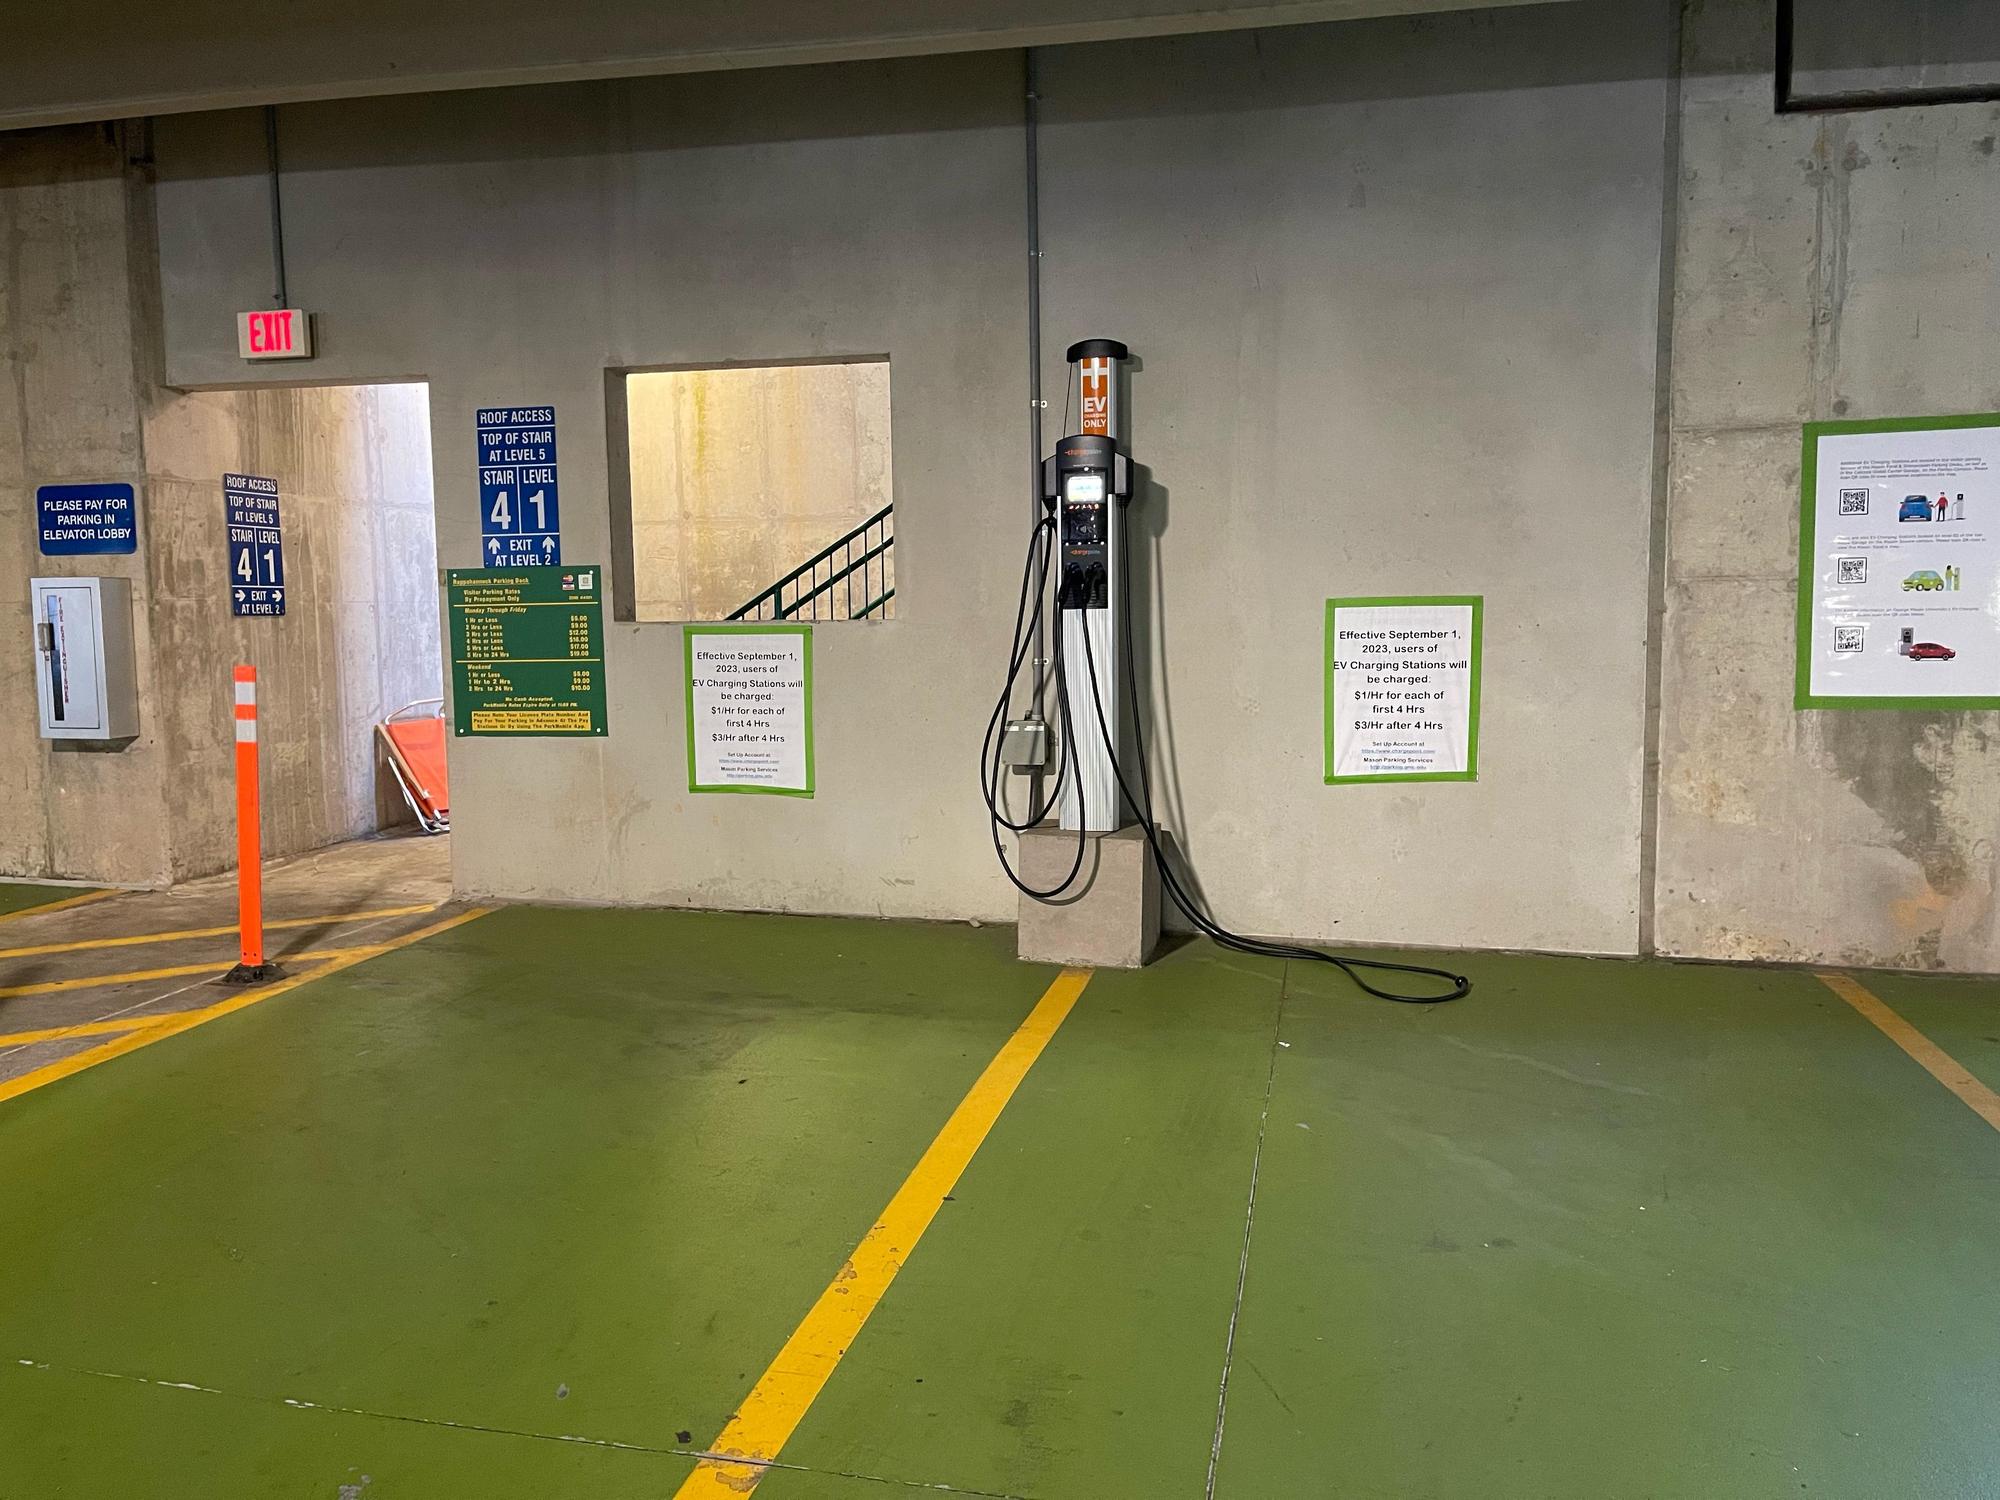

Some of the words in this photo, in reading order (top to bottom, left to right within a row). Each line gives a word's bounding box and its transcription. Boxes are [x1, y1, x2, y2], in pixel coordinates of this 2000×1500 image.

[249, 312, 292, 352] EXIT
[1084, 397, 1106, 412] EV
[480, 411, 508, 424] ROOF
[511, 409, 551, 422] ACCESS
[1084, 420, 1106, 428] ONLY
[482, 433, 501, 445] TOP
[506, 433, 518, 444] OF
[522, 431, 551, 443] STAIR
[490, 450, 501, 461] AT
[505, 449, 536, 461] LEVEL
[540, 449, 545, 460] 5
[484, 470, 514, 485] STAIR
[523, 469, 554, 483] LEVEL
[227, 476, 246, 488] ROOF
[249, 479, 276, 492] ACCESS
[44, 501, 82, 511] PLEASE
[85, 500, 103, 510] PAY
[106, 499, 127, 509] FOR
[229, 496, 243, 507] TOP
[246, 497, 254, 508] OF
[257, 499, 277, 510] STAIR
[529, 490, 545, 528] 1
[491, 492, 511, 530] 4
[57, 514, 101, 525] PARKING
[105, 514, 114, 524] IN
[235, 511, 243, 522] AT
[246, 512, 267, 523] LEVEL
[269, 514, 273, 524] 5
[44, 529, 95, 540] ELEVATOR
[98, 528, 131, 538] LOBBY
[232, 529, 253, 542] STAIR
[259, 531, 280, 544] LEVEL
[510, 539, 532, 551] EXIT
[237, 548, 252, 582] 4
[264, 549, 275, 583] 1
[495, 555, 507, 567] AT
[511, 555, 541, 566] LEVEL
[545, 554, 550, 565] 2
[251, 591, 267, 601] EXIT
[241, 604, 250, 614] AT
[252, 604, 273, 614] LEVEL
[276, 605, 280, 614] 2
[1340, 631, 1385, 639] Effective
[1389, 630, 1448, 640] September
[1452, 630, 1461, 639] 1,
[1362, 645, 1391, 654] 2023,
[1427, 644, 1438, 653] of
[697, 652, 735, 660] Effective
[738, 652, 786, 661] September
[789, 652, 797, 661] 1,
[716, 665, 740, 674] 2023,
[769, 665, 778, 673] of
[1333, 661, 1347, 670] EV
[1350, 661, 1399, 671] Charging
[1402, 661, 1446, 669] Stations
[1449, 661, 1467, 669] will
[707, 680, 747, 689] Charging
[750, 680, 785, 688] Stations
[788, 680, 803, 688] will
[1367, 675, 1380, 683] be
[1383, 675, 1431, 685] charged:
[734, 693, 774, 702] charged:
[1354, 691, 1384, 700] $1/Hr
[1386, 691, 1402, 699] for
[1404, 691, 1431, 700] each
[1434, 691, 1444, 699] of
[712, 706, 735, 715] $1/Hr
[737, 707, 750, 715] for
[752, 707, 774, 715] each
[777, 707, 785, 715] of
[1373, 705, 1393, 714] first
[1397, 705, 1403, 713] 4
[1406, 705, 1425, 713] Hrs
[726, 719, 744, 727] first
[754, 720, 770, 728] Hrs
[1354, 721, 1384, 730] $3/Hr
[1386, 721, 1411, 730] after
[1414, 721, 1421, 729] 4
[1424, 722, 1443, 730] Hrs
[712, 734, 736, 742] $3/Hr
[738, 734, 759, 742] after
